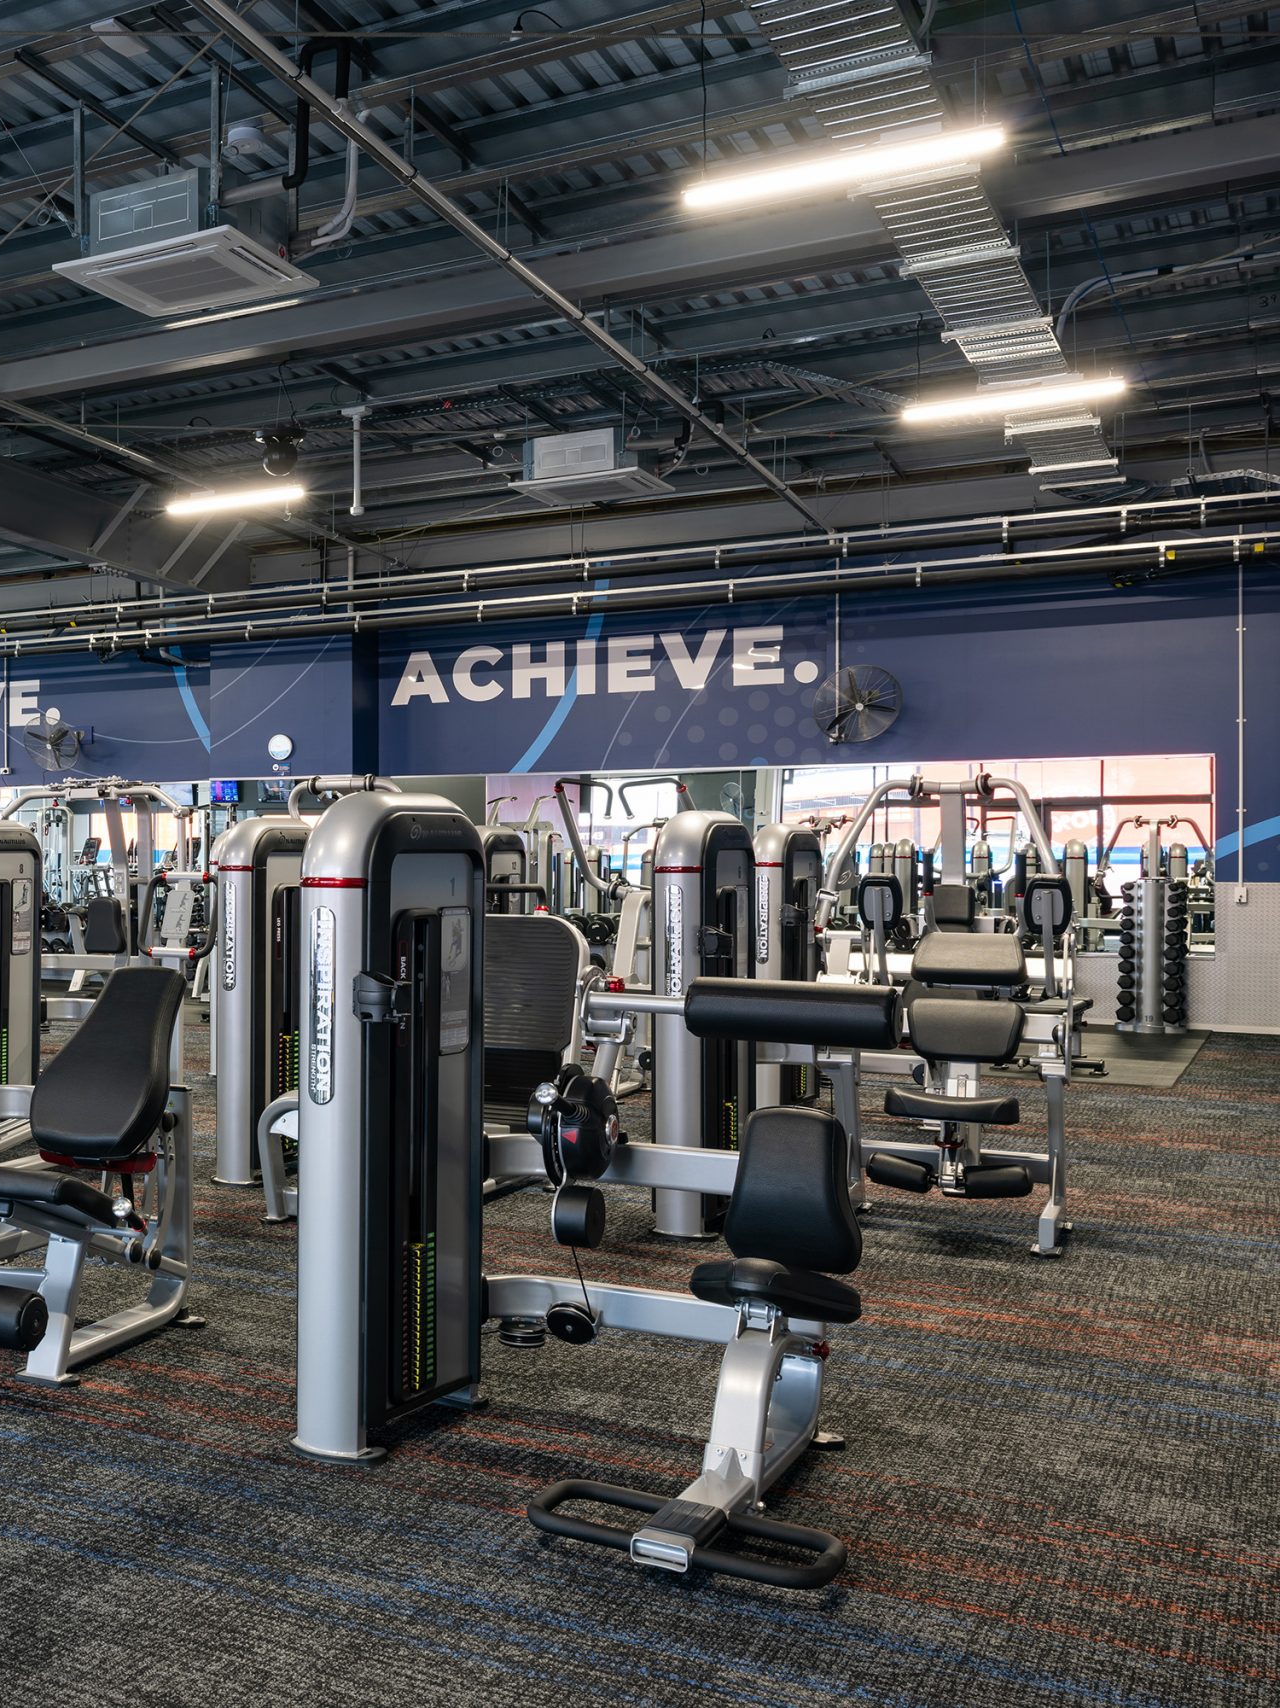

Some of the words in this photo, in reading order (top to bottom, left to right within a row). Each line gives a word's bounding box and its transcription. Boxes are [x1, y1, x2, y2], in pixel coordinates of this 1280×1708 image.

[390, 624, 819, 707] ACHIEVE.
[18, 863, 24, 874] 8
[448, 876, 456, 897] 1
[399, 956, 407, 979] BACK
[316, 919, 332, 1092] INSPIRATION
